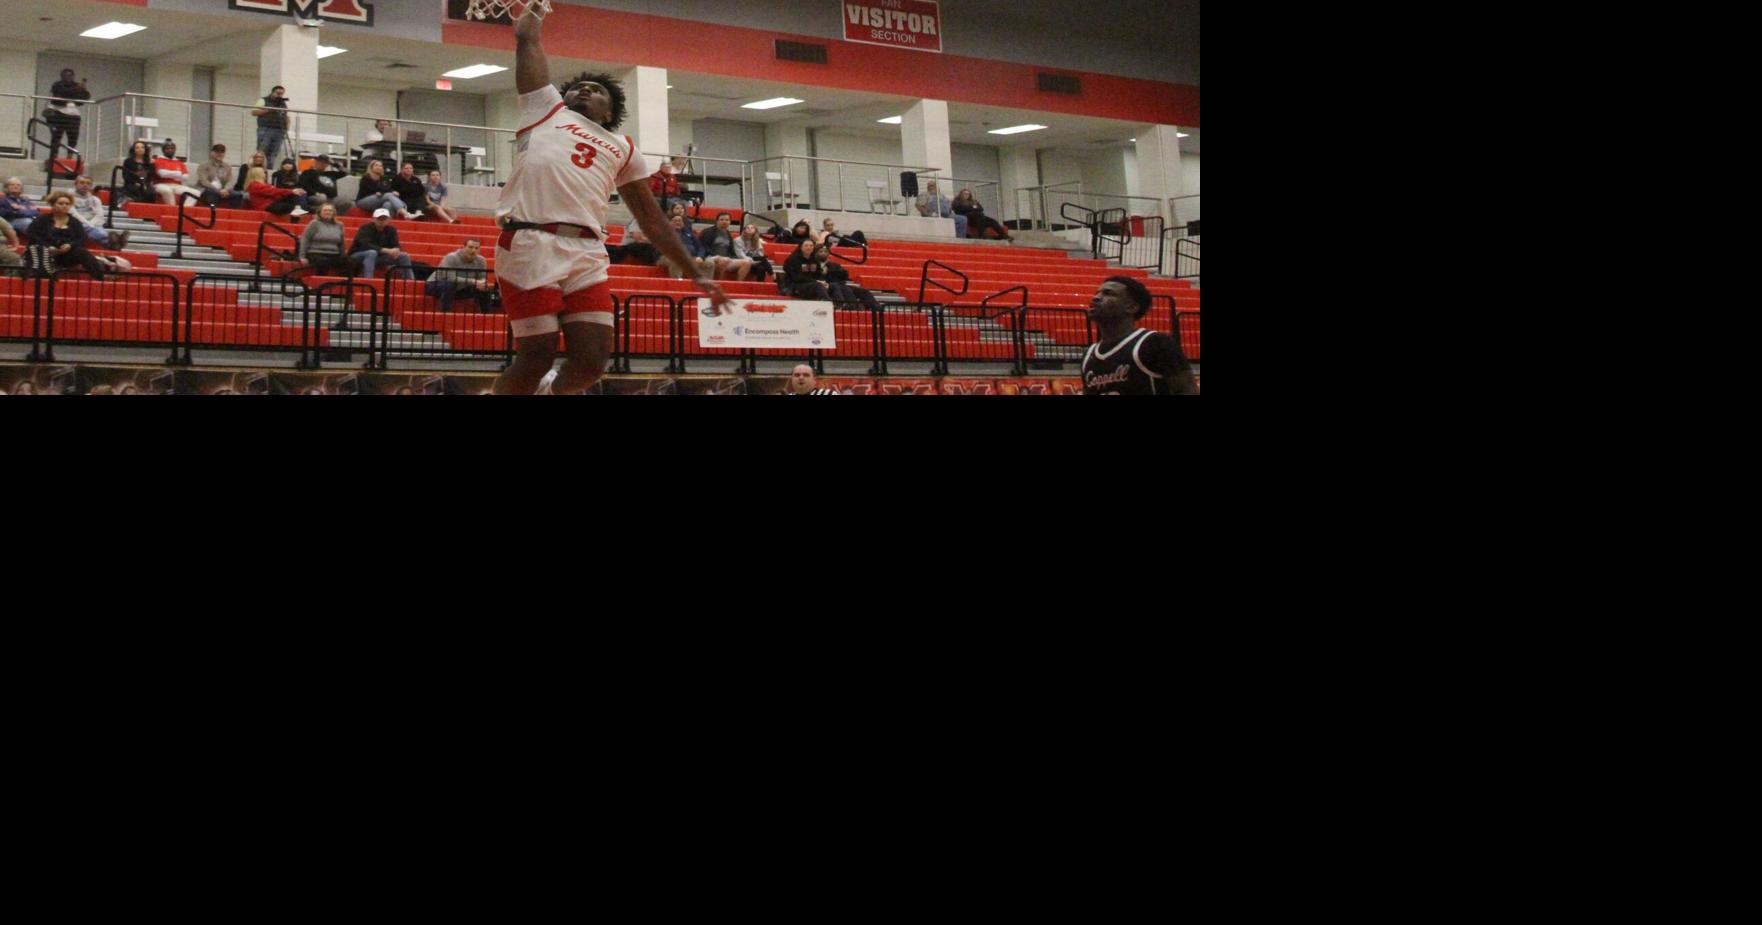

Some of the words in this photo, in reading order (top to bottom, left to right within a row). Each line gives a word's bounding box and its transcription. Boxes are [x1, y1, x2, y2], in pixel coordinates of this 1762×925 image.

[846, 3, 936, 35] VISITOR
[871, 29, 916, 43] SECTION
[555, 124, 622, 159] Marcus
[571, 142, 597, 169] 3
[744, 328, 778, 336] Encompass
[1086, 364, 1130, 389] Coppell
